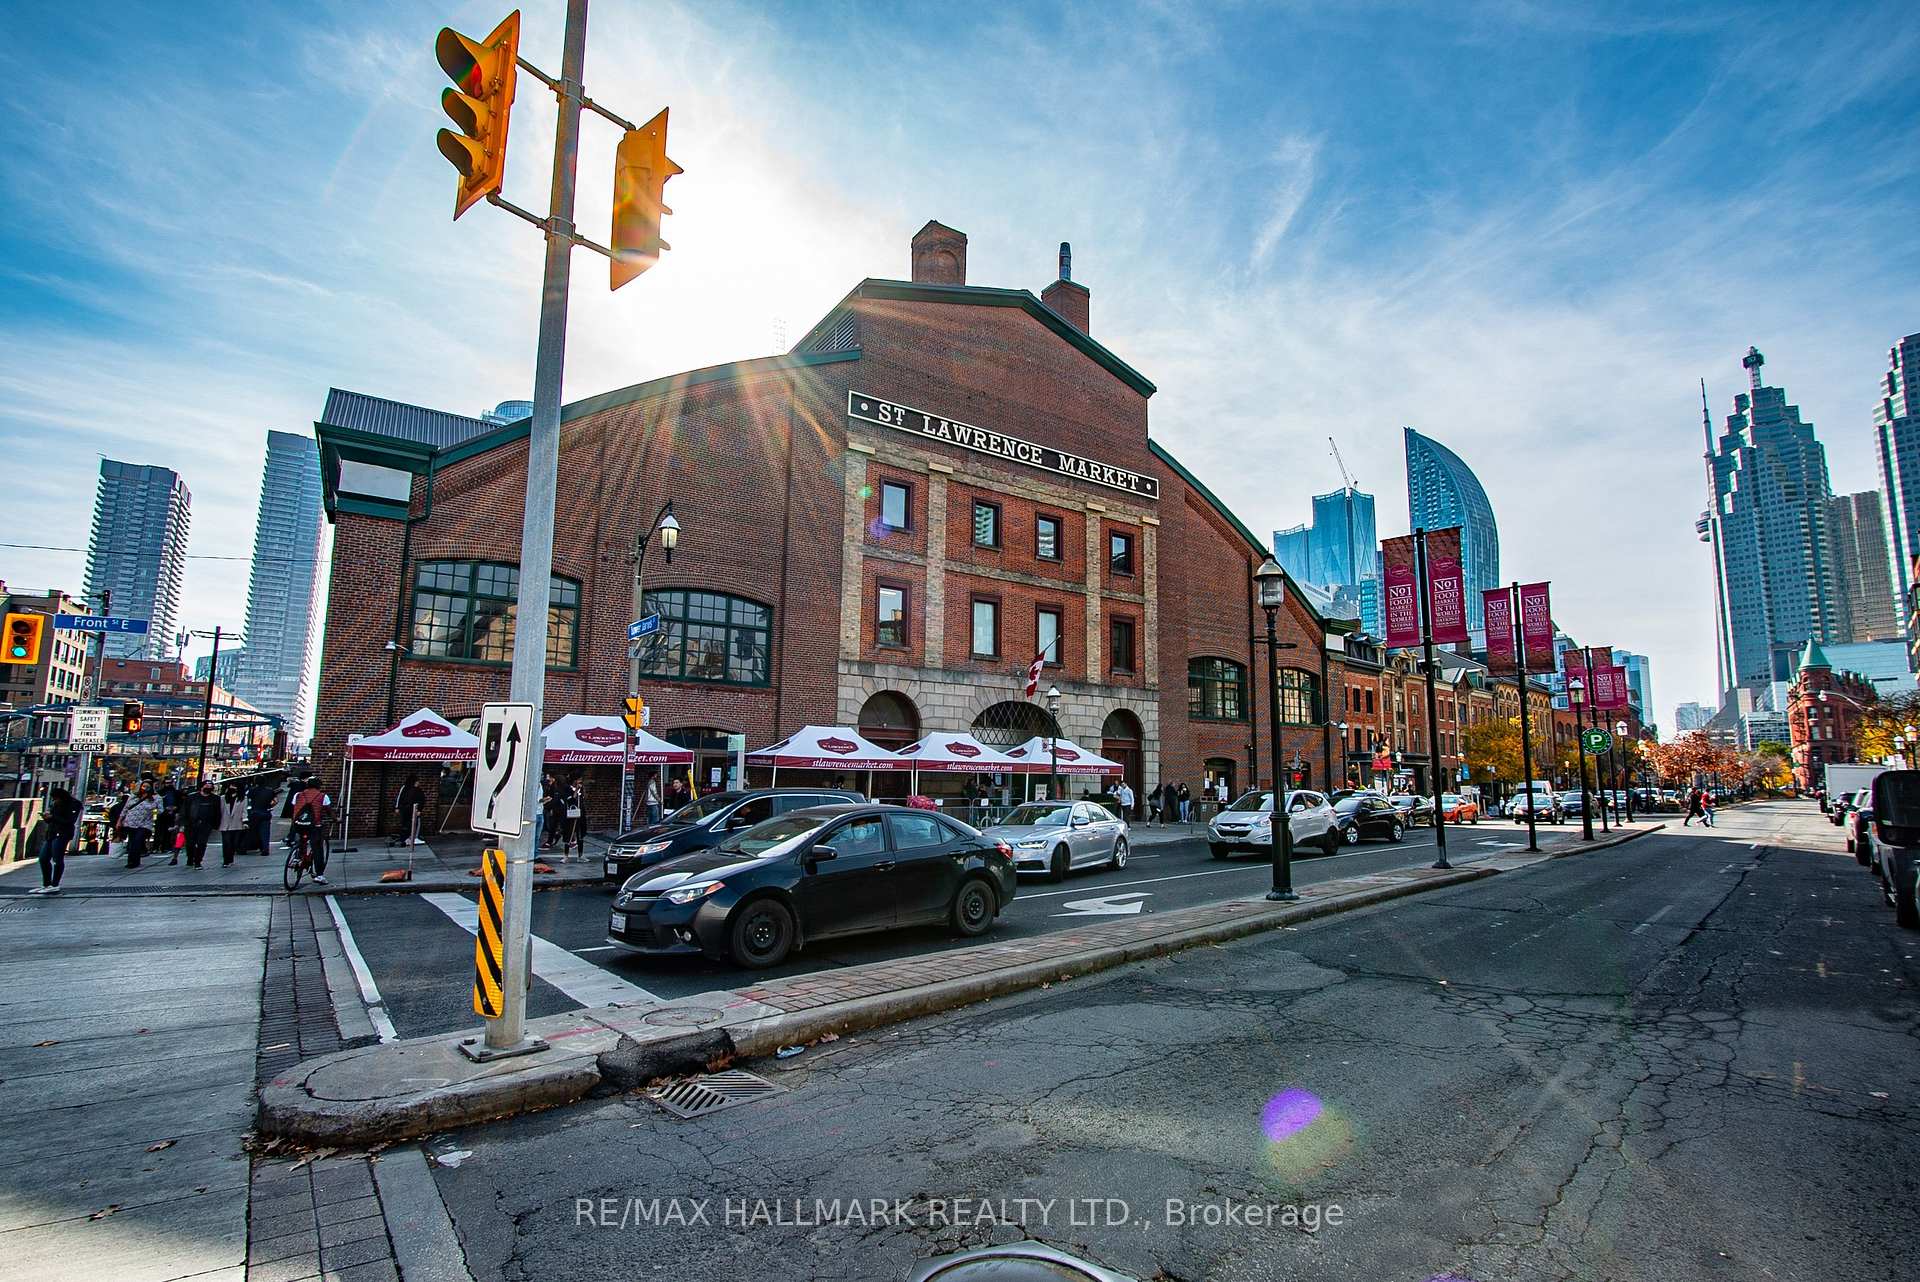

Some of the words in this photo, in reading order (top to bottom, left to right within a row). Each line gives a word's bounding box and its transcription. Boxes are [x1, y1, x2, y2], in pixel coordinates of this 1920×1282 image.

[922, 415, 1043, 464] LAWRENCE
[1058, 454, 1139, 491] MARKET
[1435, 592, 1459, 600] FOOD
[1390, 598, 1413, 606] FOOD
[74, 617, 108, 628] Front
[121, 620, 130, 630] E
[384, 749, 478, 760] stlawrencemarket.c
[560, 751, 668, 762] stlawrencemet.com
[812, 758, 894, 769] stlawrencemarket.com
[1056, 765, 1110, 774] tlawrencemarket.com
